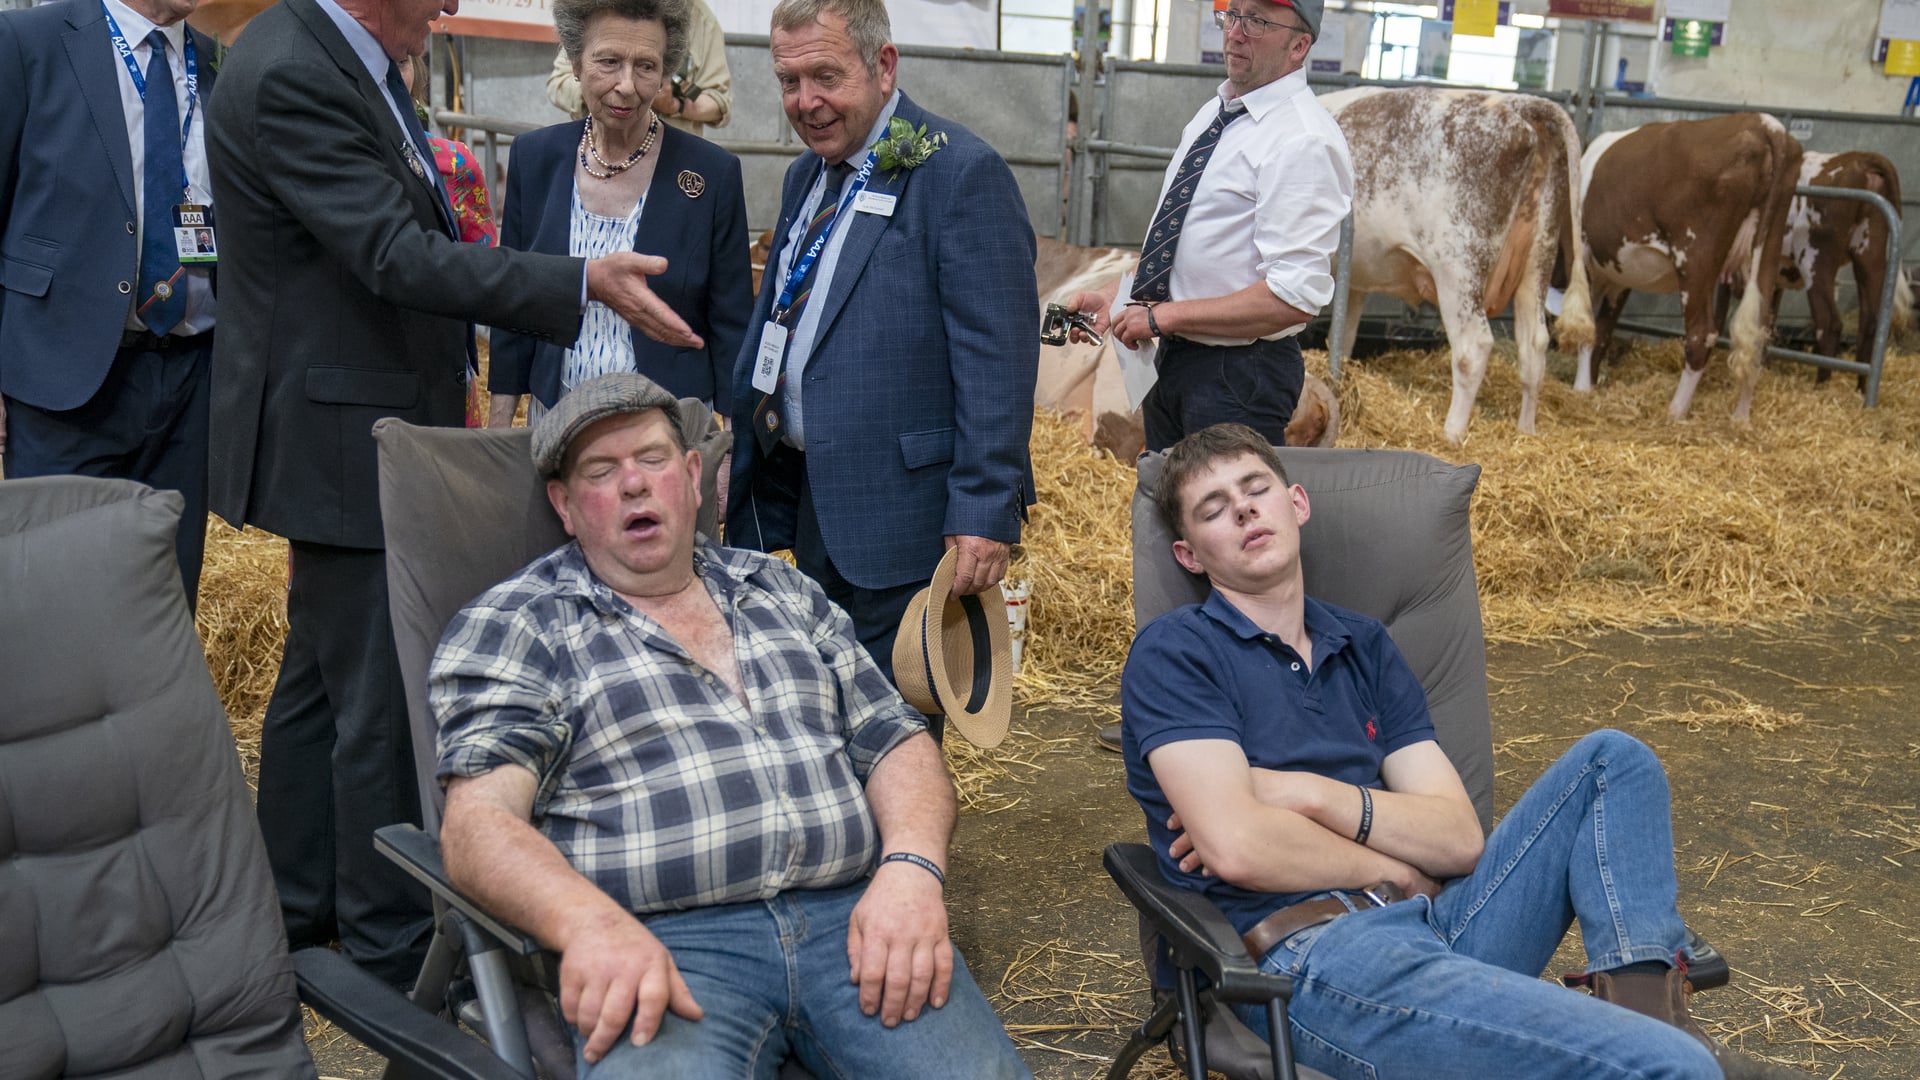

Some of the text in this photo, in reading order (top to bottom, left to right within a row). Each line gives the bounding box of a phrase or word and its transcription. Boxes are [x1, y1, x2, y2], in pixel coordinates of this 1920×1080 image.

[112, 36, 131, 57] AAA
[187, 73, 198, 96] AAA
[856, 159, 874, 182] AAA
[183, 213, 203, 224] AAA
[806, 235, 825, 258] AAA
